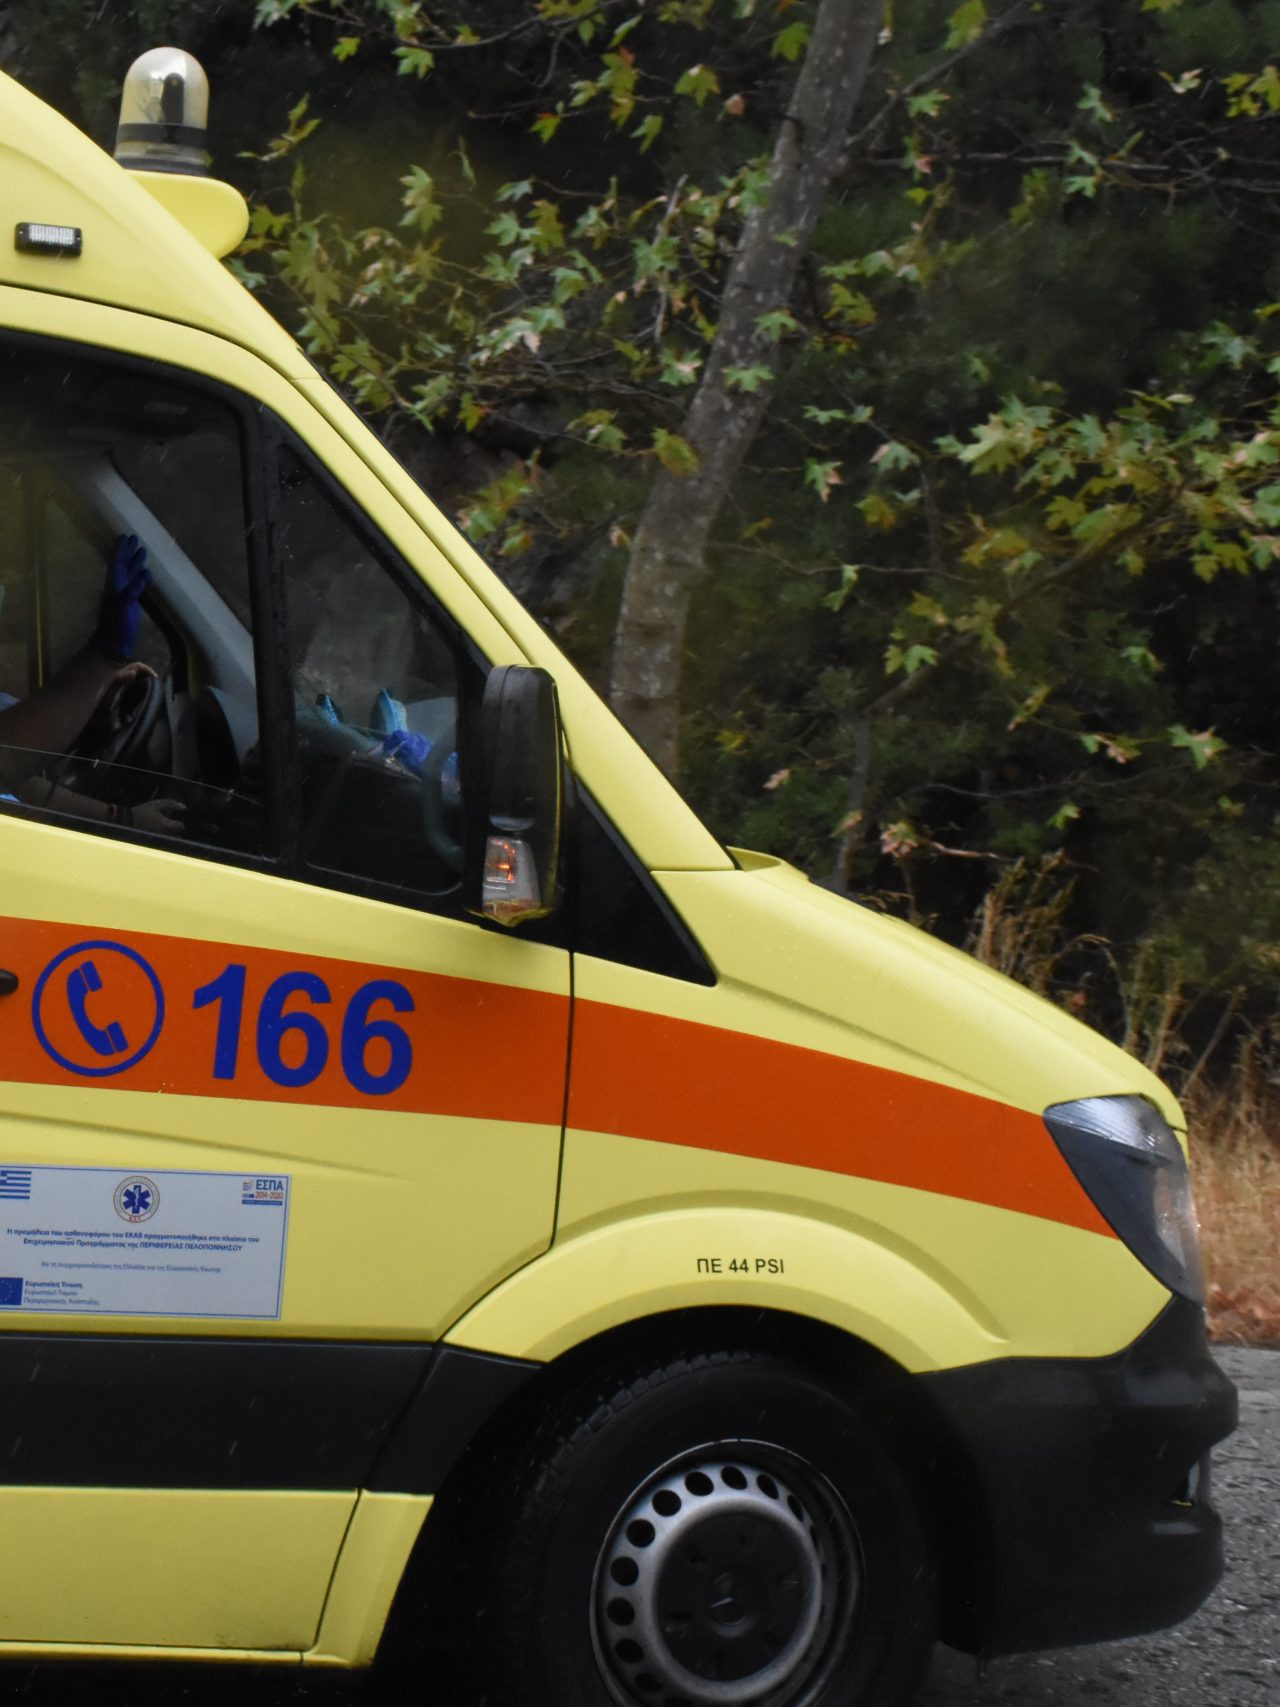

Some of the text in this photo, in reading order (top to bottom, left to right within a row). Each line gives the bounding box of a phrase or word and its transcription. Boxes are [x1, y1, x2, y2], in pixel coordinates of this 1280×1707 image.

[193, 963, 416, 1096] 166
[256, 1179, 284, 1191] ΕΣΠΑ
[729, 1258, 749, 1273] 44
[755, 1258, 784, 1274] PSI
